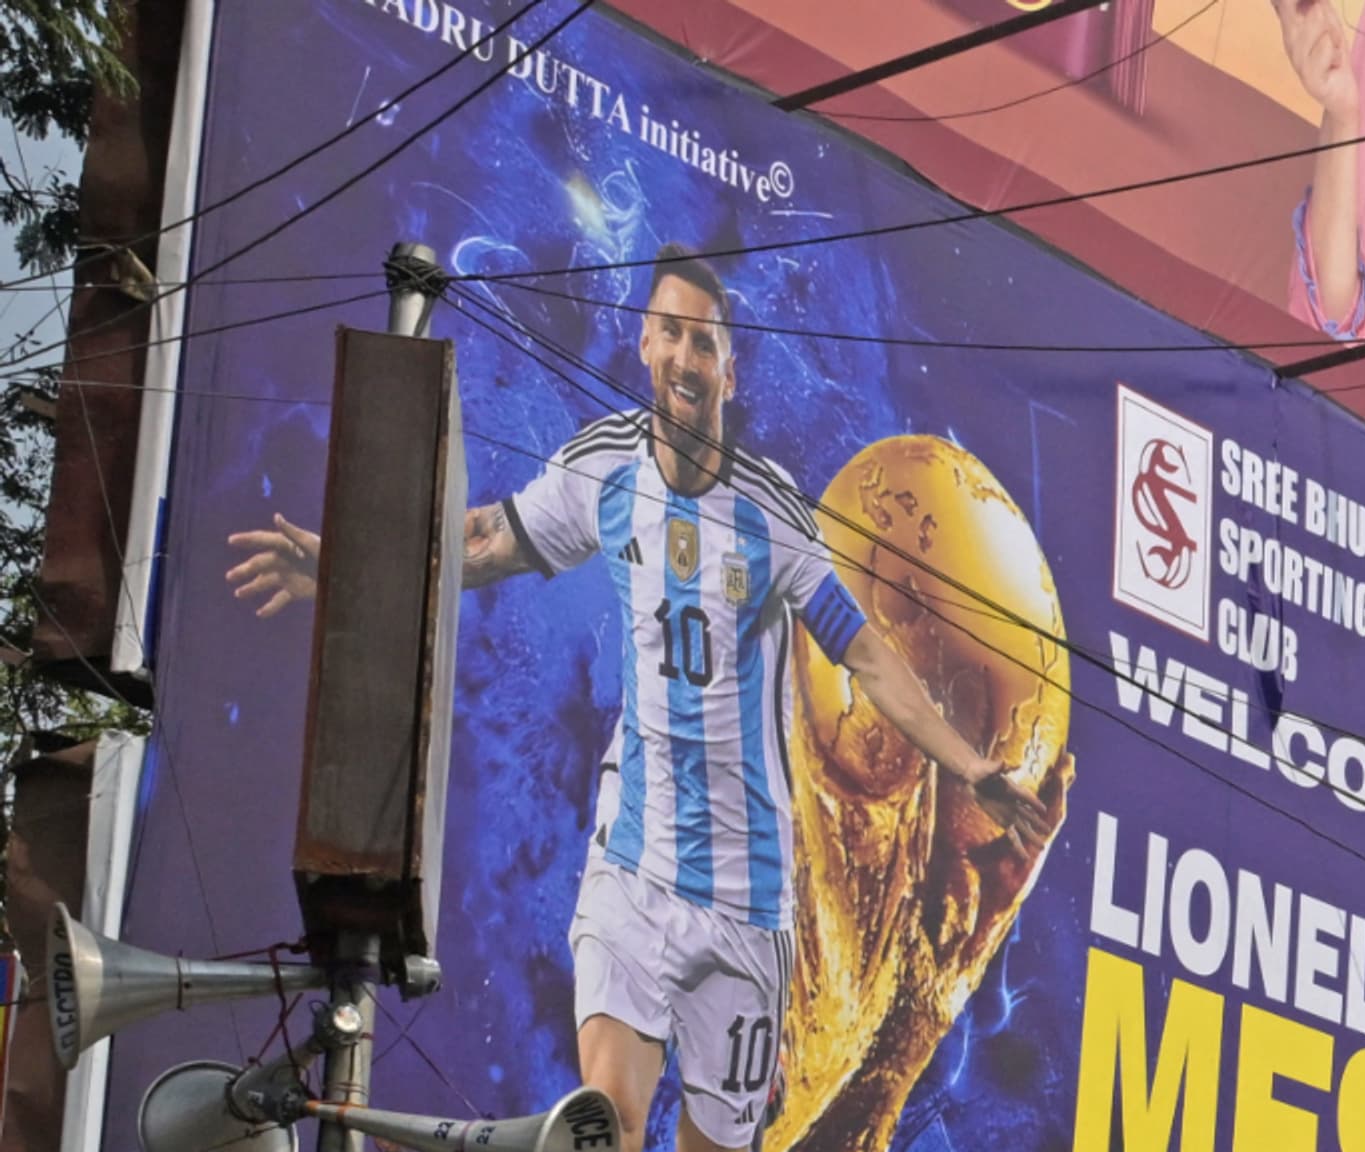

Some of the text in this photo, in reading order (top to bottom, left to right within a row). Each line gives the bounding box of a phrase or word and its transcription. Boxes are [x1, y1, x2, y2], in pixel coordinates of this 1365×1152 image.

[507, 36, 632, 134] DUTTA
[1221, 438, 1298, 525] SREE
[654, 598, 714, 688] 10
[722, 1014, 773, 1092] 10
